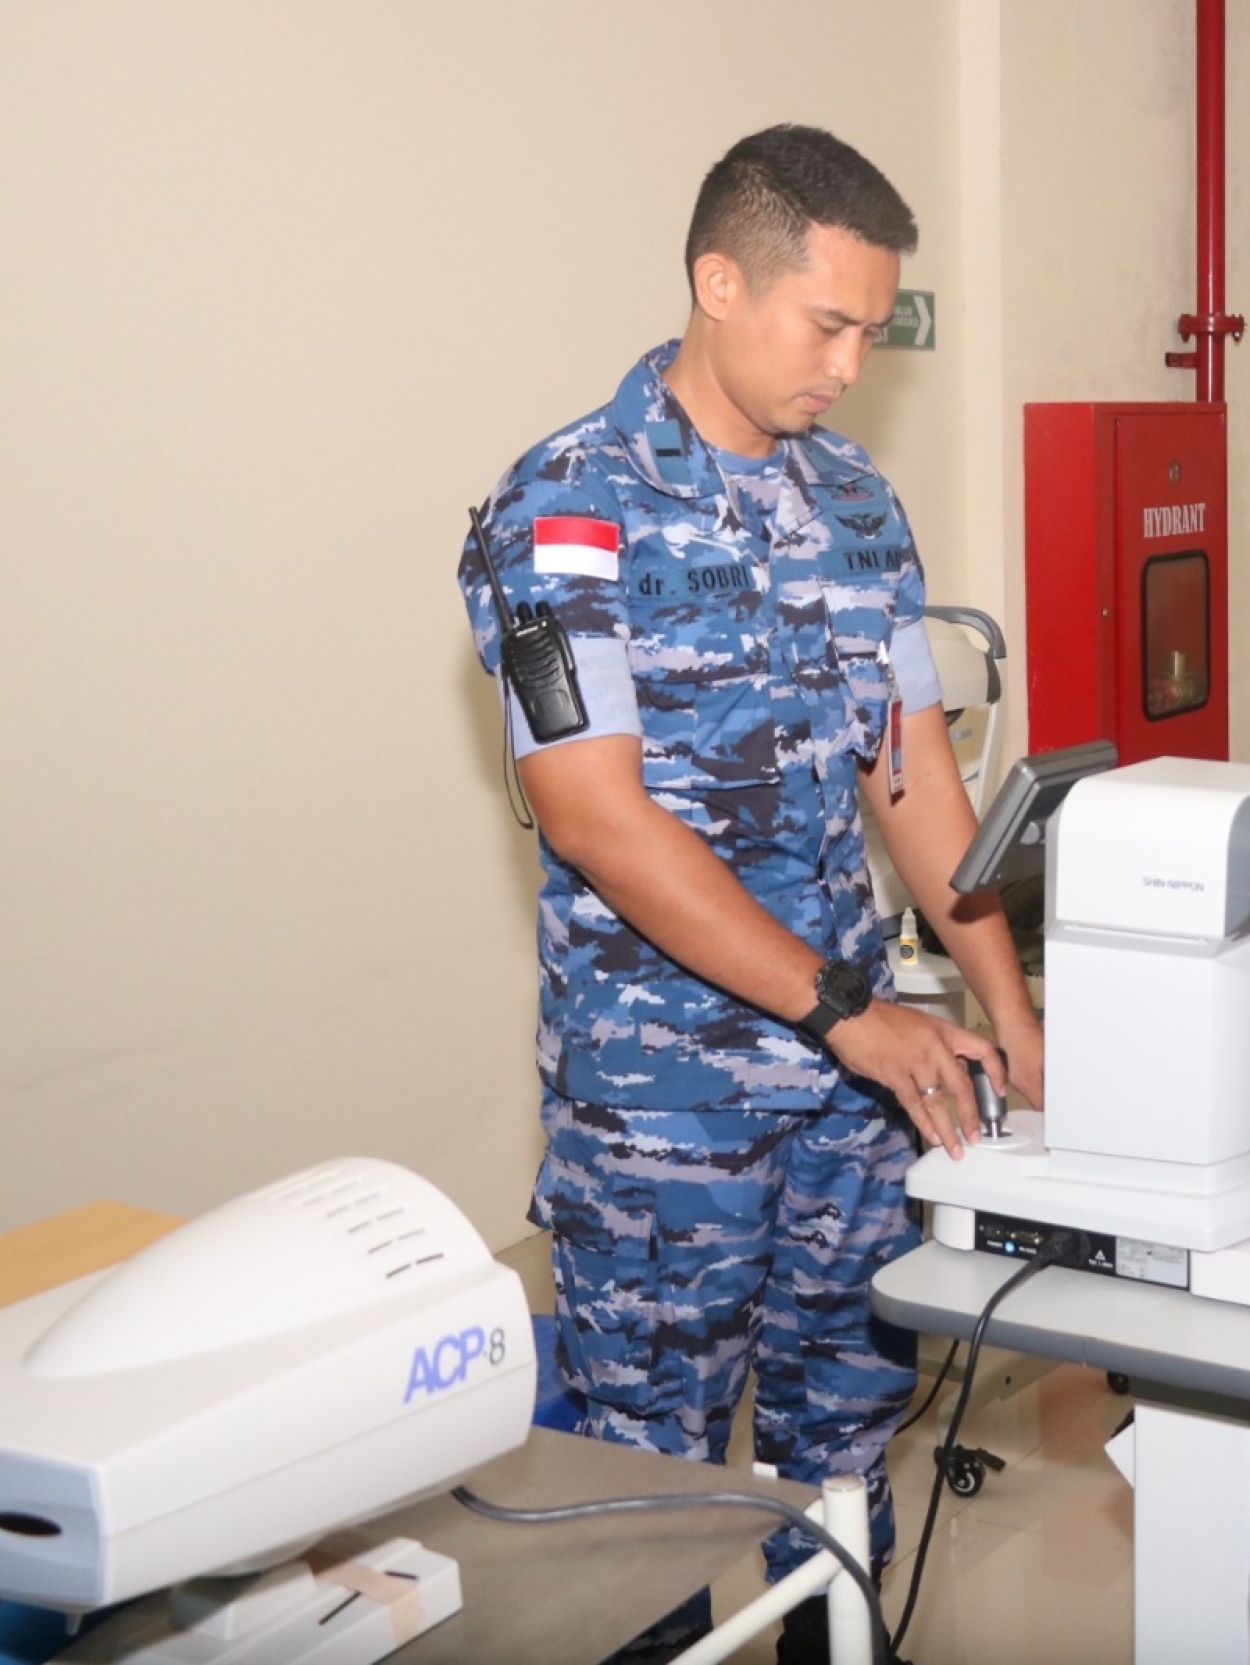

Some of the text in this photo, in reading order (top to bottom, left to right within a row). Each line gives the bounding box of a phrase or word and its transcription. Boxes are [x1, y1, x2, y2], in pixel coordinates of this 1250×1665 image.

[1143, 502, 1206, 538] HYDRANT
[843, 550, 880, 571] TNI
[638, 564, 750, 596] dr. SOBRI
